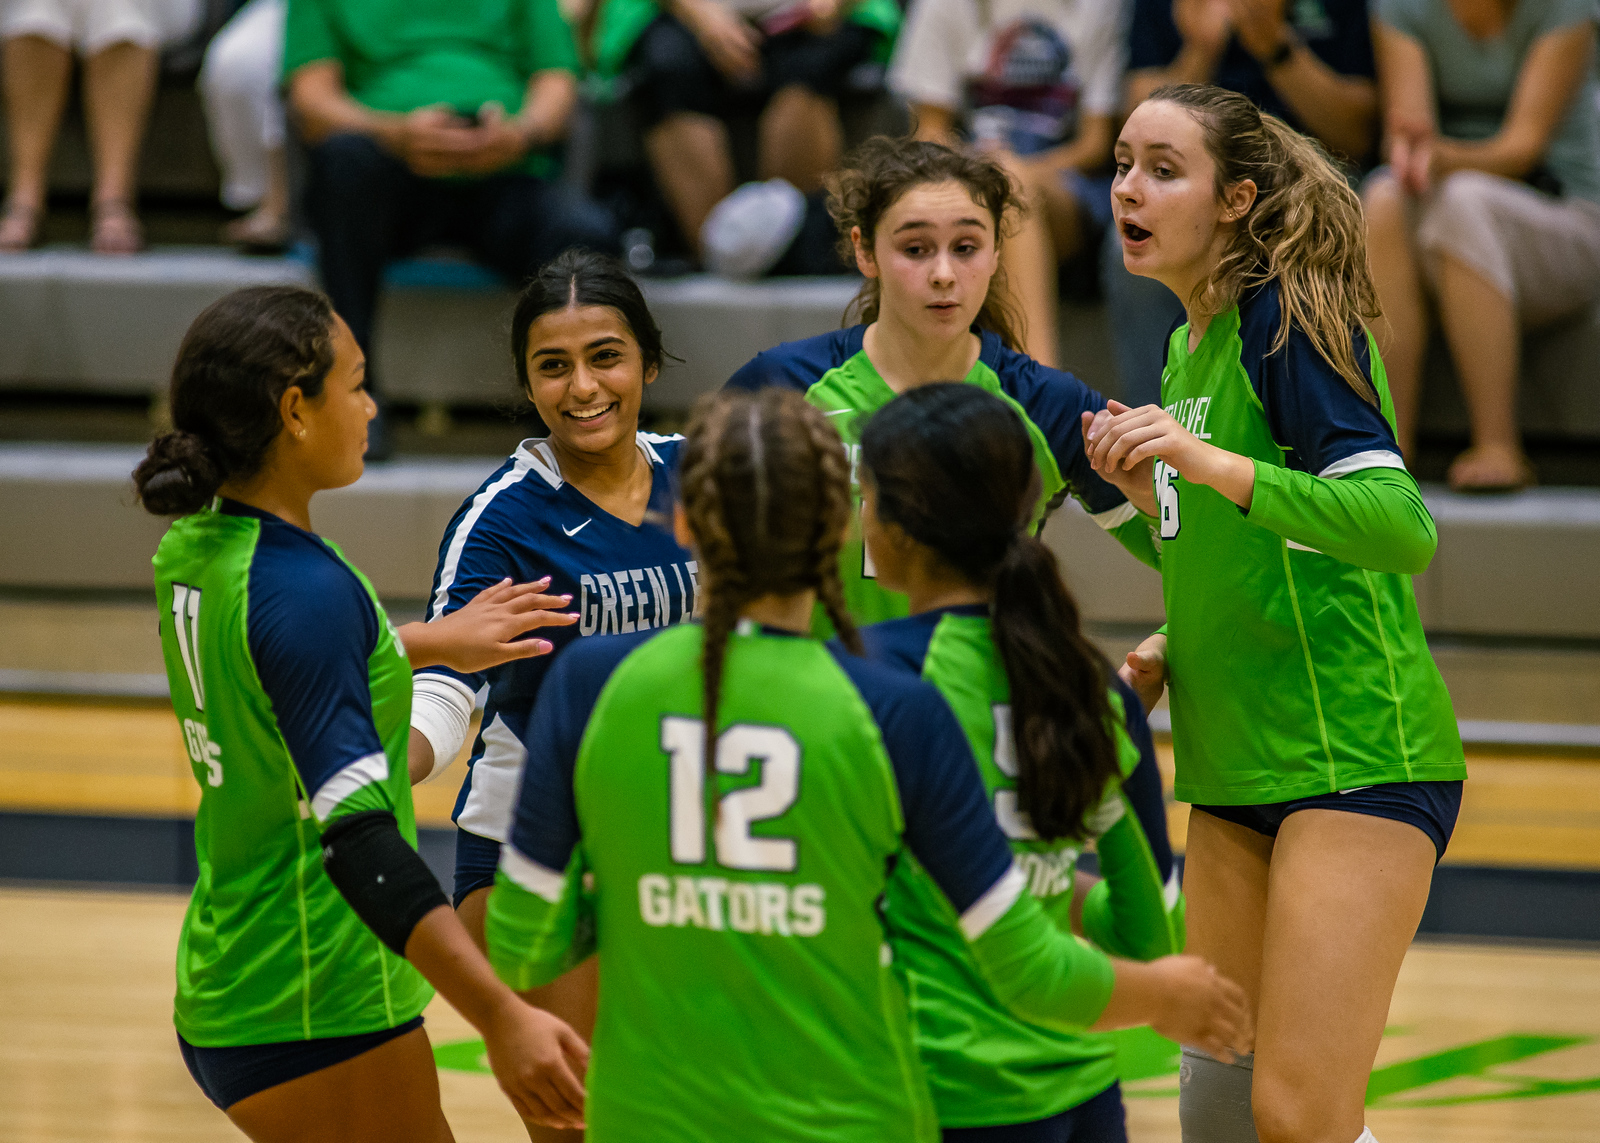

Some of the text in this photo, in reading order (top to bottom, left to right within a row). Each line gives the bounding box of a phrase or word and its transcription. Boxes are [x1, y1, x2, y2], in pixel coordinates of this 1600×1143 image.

[171, 581, 203, 713] 11
[579, 566, 671, 637] GREEN
[660, 714, 802, 874] 12
[638, 873, 826, 937] GATORS
